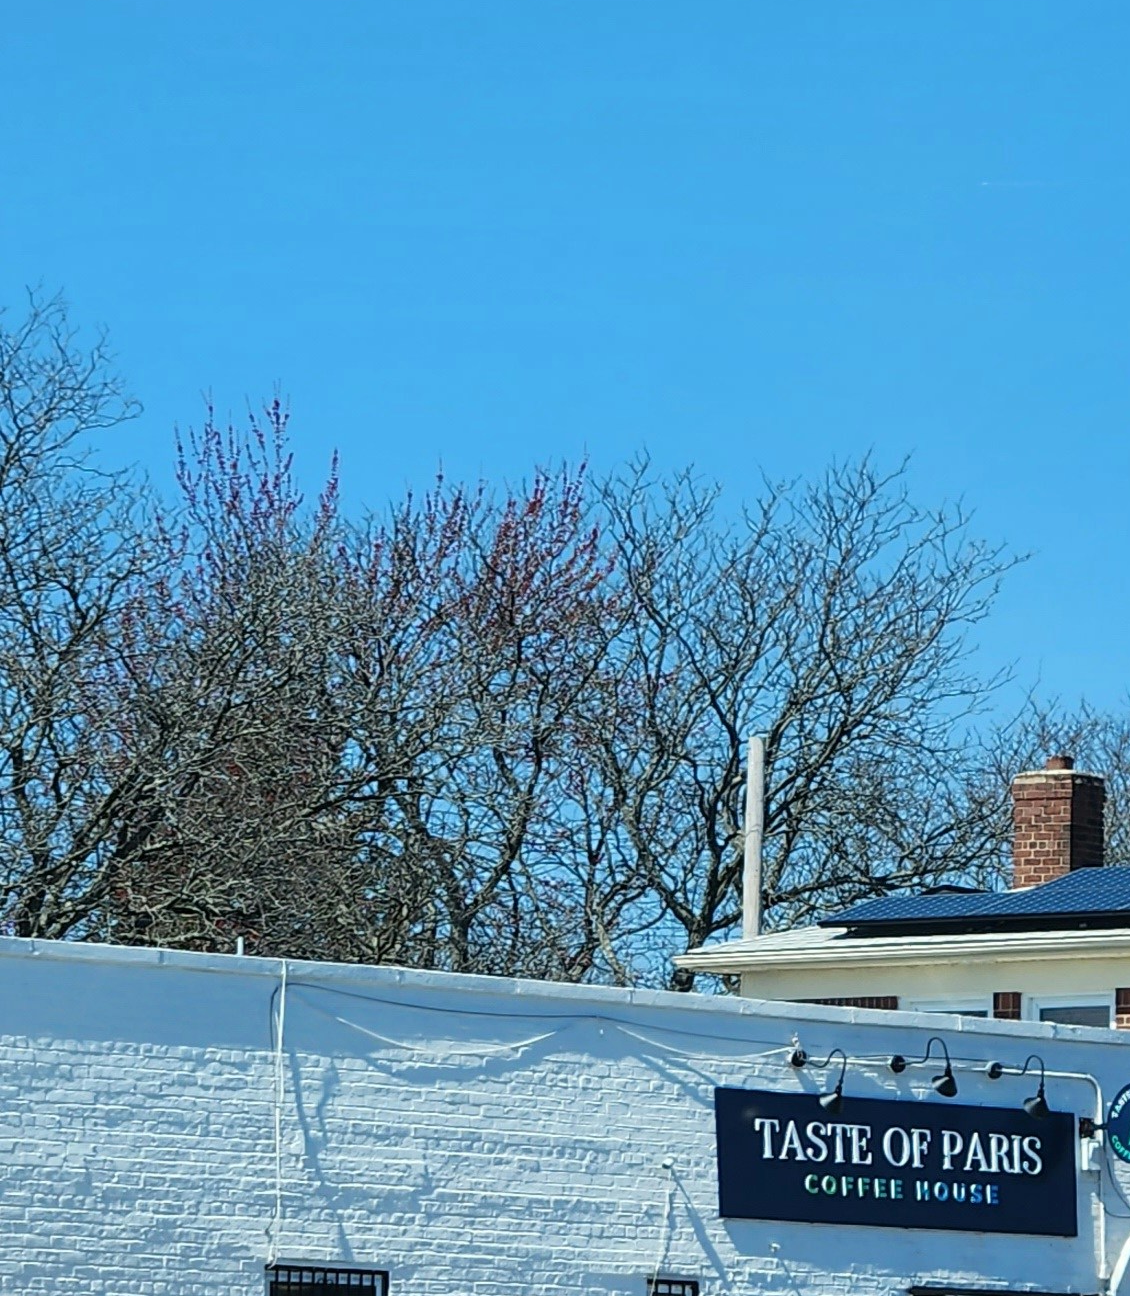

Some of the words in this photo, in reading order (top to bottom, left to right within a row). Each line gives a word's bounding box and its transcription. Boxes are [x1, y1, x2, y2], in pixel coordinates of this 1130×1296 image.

[754, 1118, 873, 1165] TASTE
[882, 1126, 931, 1168] OF
[941, 1129, 1043, 1175] PARIS
[804, 1174, 903, 1200] COFFEE
[915, 1180, 999, 1205] HOUSE
